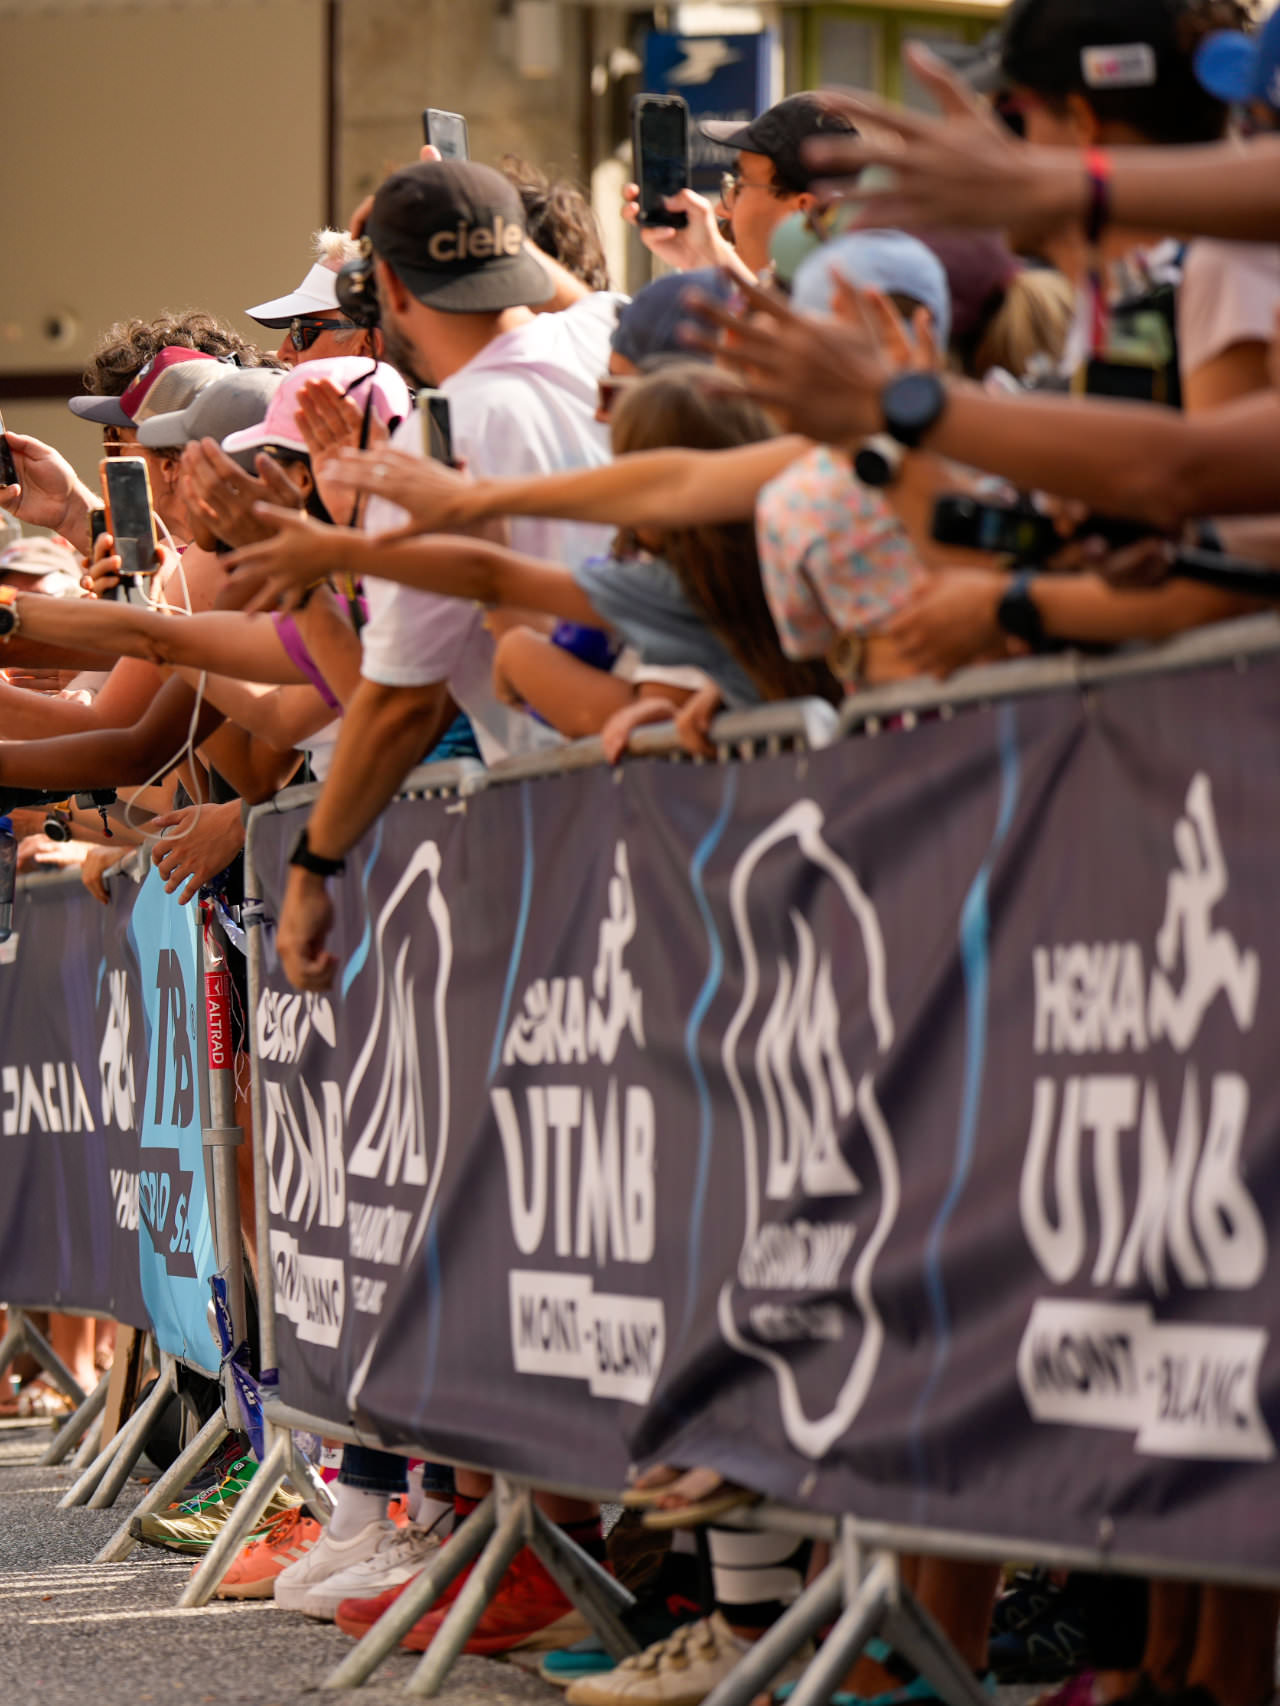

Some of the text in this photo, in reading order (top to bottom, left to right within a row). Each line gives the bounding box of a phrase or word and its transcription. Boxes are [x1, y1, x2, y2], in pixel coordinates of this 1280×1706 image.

[428, 215, 523, 262] ciele
[208, 1000, 225, 1064] ALTRAD
[1034, 941, 1148, 1053] HOKA
[491, 1076, 656, 1266] UTMB
[1021, 1064, 1268, 1294] UTMB
